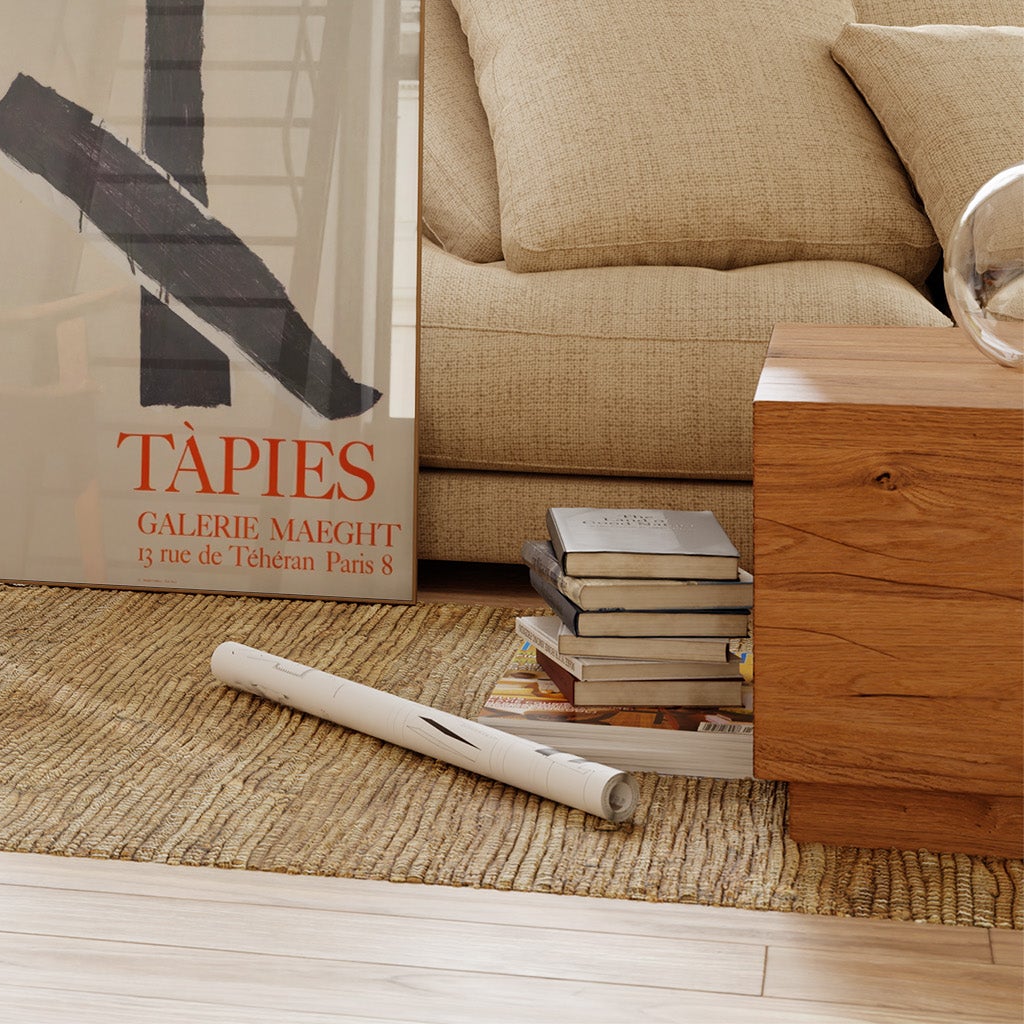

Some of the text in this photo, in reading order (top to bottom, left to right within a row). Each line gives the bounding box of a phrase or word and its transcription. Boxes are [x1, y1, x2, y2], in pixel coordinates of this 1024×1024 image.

[116, 420, 376, 503] TÀPIES
[137, 511, 402, 548] GALERIE MAEGHT
[138, 544, 393, 575] 13 rue de Téhéran Paris 8
